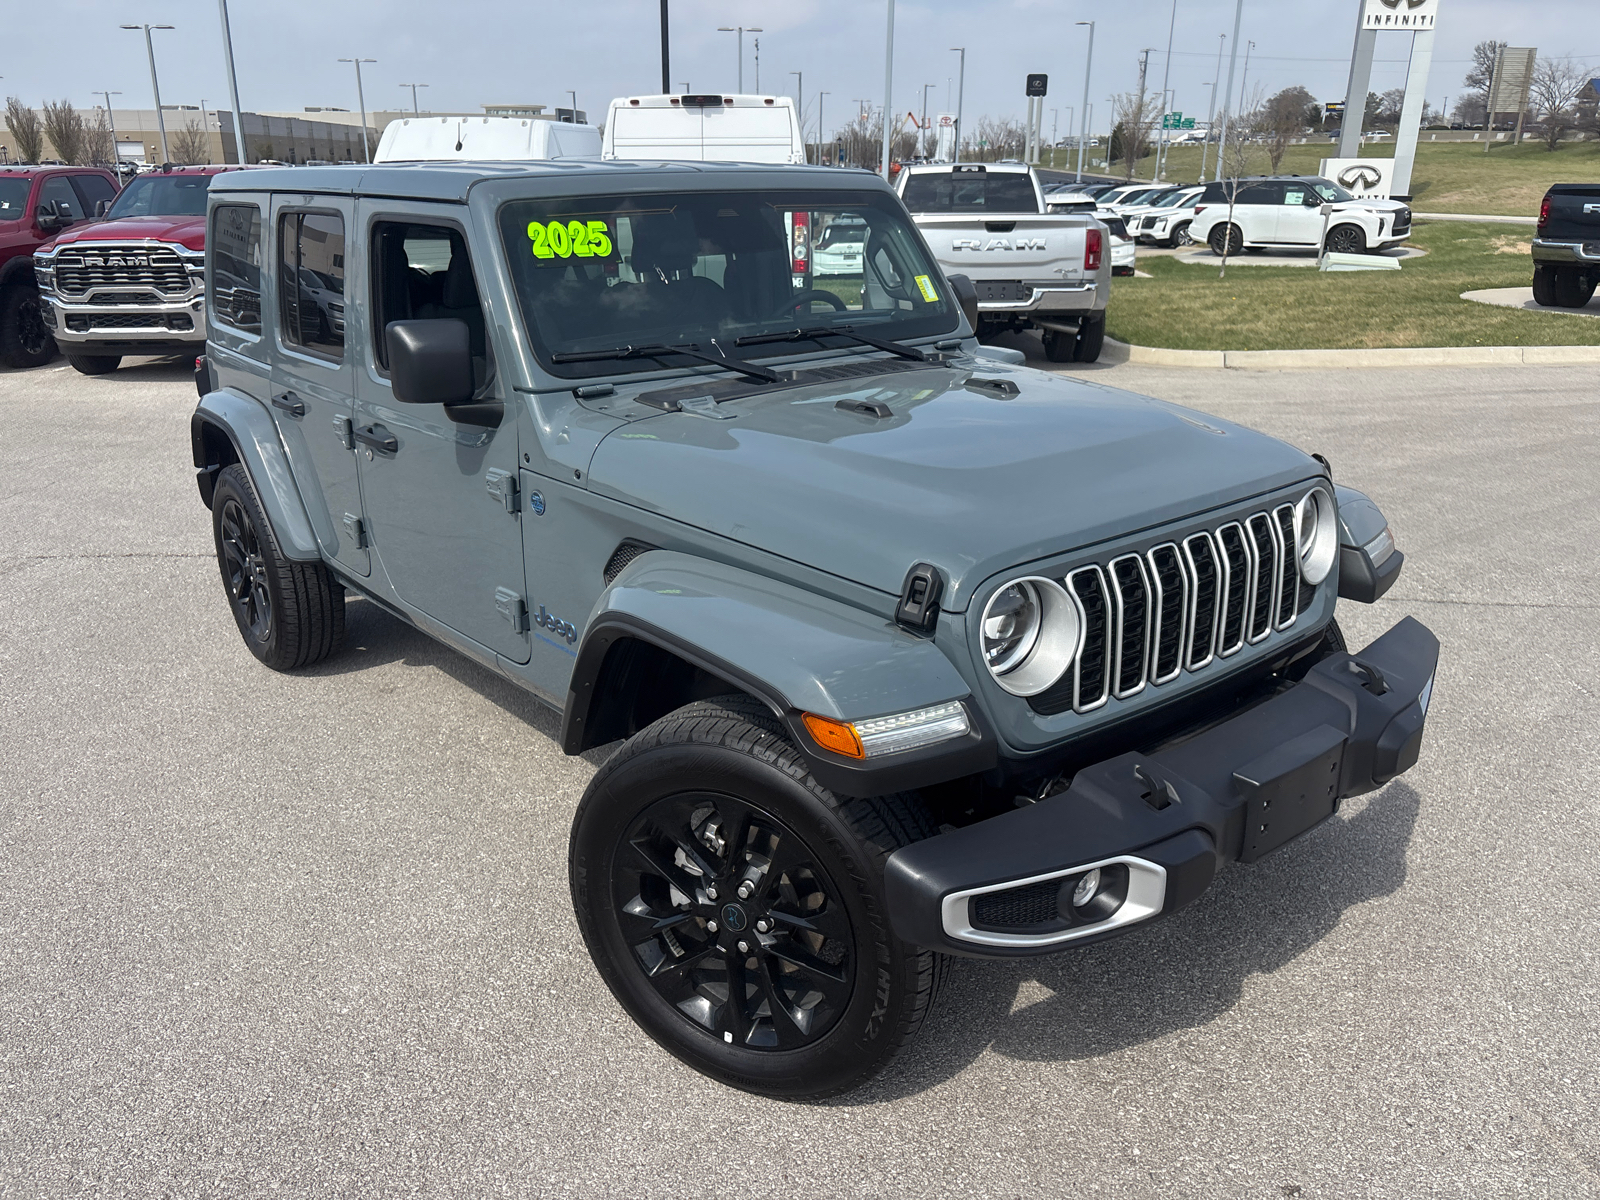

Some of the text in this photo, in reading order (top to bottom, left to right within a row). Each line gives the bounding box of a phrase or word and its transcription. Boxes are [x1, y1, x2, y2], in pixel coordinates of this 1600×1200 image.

[1366, 14, 1434, 26] INFINITI
[527, 220, 613, 259] 2025
[952, 237, 1047, 252] RAM
[84, 256, 149, 267] RAM
[533, 603, 578, 646] Jeep
[863, 967, 892, 1042] HTX2
